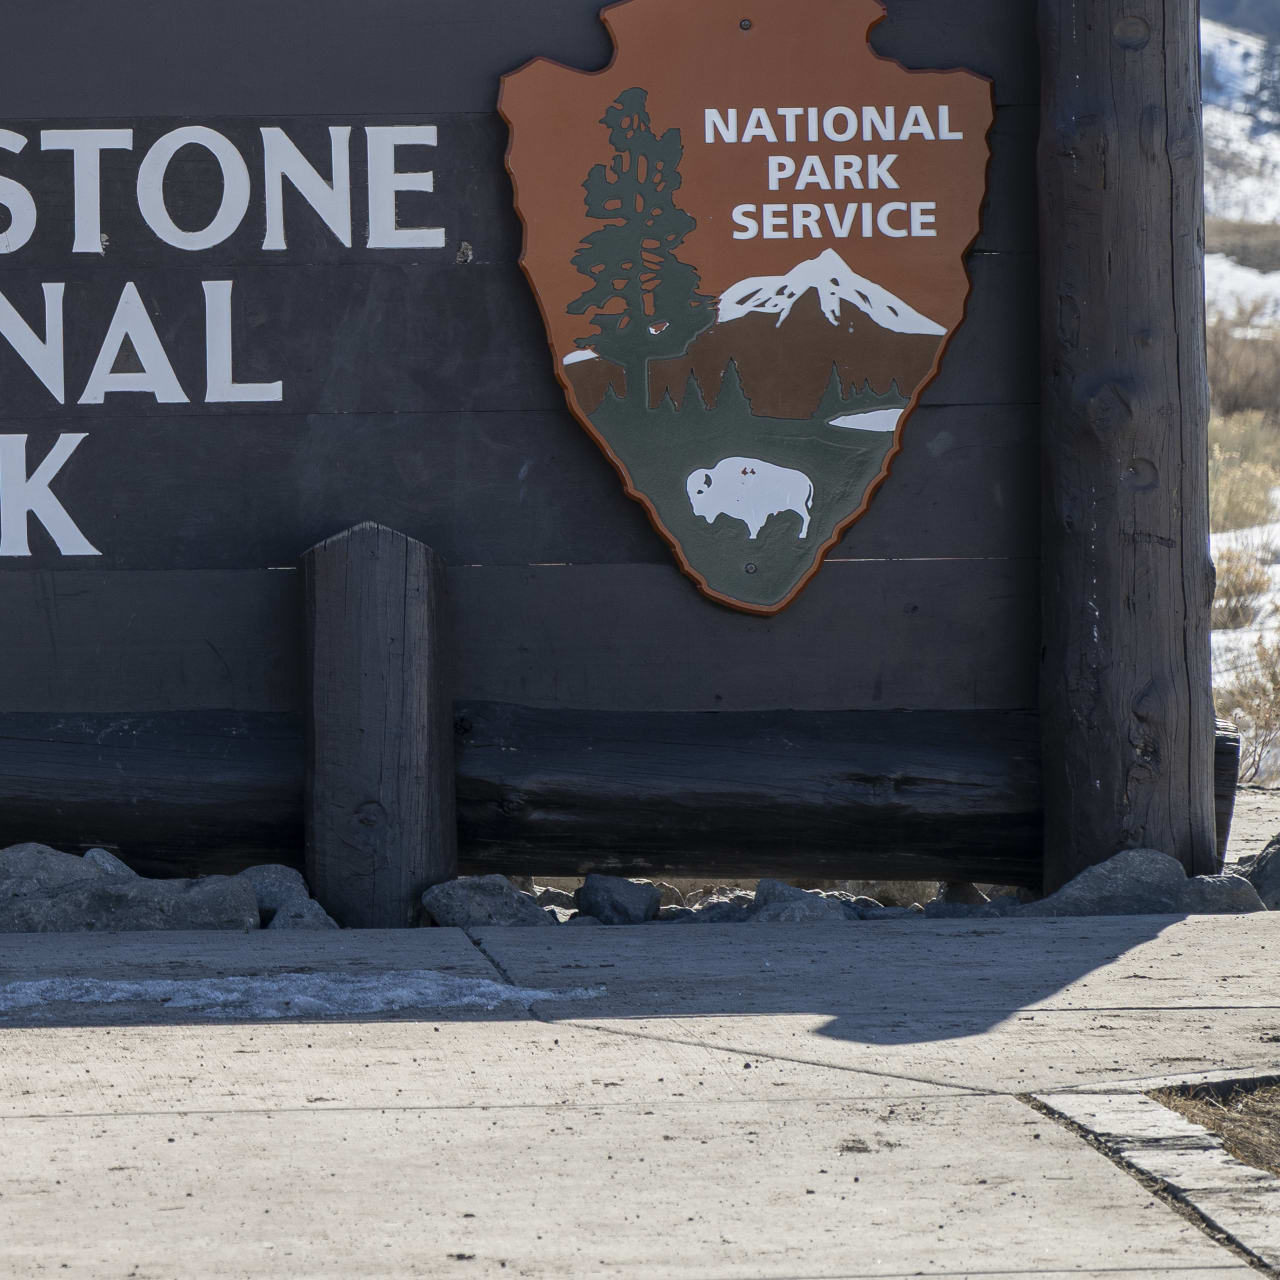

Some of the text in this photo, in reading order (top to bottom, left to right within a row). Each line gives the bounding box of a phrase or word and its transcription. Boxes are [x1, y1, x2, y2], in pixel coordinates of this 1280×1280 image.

[703, 105, 964, 144] NATIONAL
[768, 153, 900, 191] PARK
[731, 201, 938, 240] SERVICE
